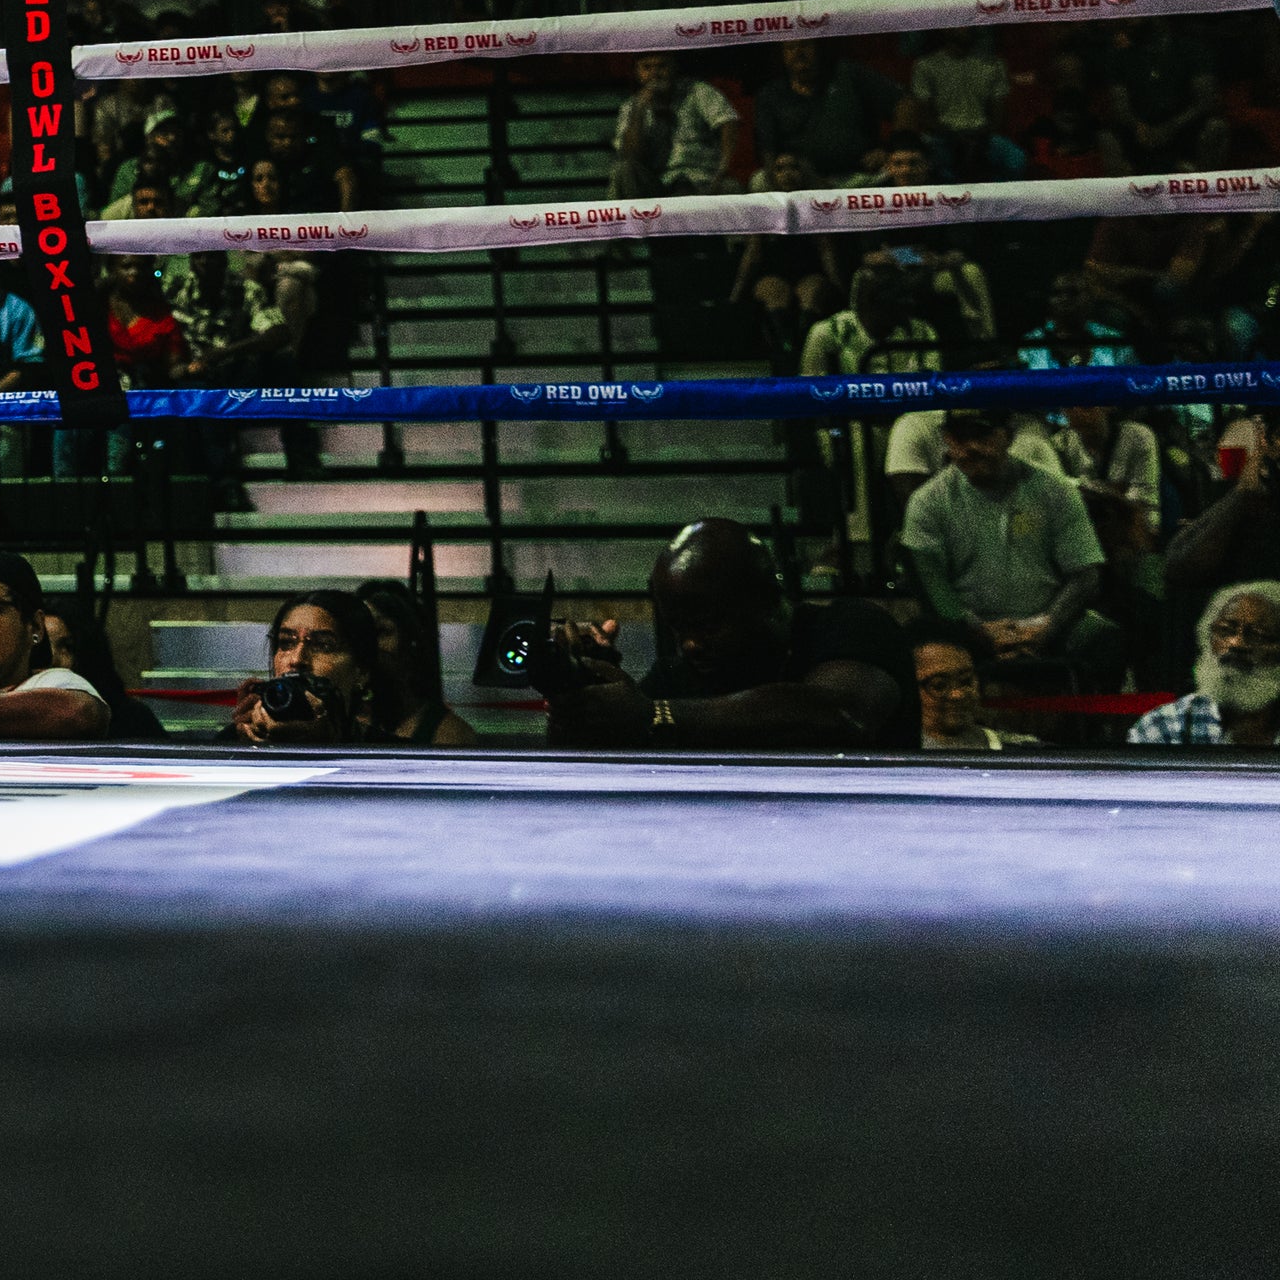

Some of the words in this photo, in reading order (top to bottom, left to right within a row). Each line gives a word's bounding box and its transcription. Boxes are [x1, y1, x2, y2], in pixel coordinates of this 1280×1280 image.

[710, 19, 748, 36] RED
[752, 15, 793, 33] OWL
[424, 35, 461, 51] RED
[464, 32, 503, 49] OWL
[147, 46, 182, 62] RED
[186, 44, 223, 61] OWL
[27, 61, 63, 174] OWL
[1168, 178, 1209, 195] RED
[1215, 176, 1261, 193] OWL
[846, 194, 884, 210] RED
[891, 192, 934, 208] OWL
[544, 211, 581, 227] RED
[587, 207, 627, 223] OWL
[257, 226, 292, 240] RED
[296, 225, 335, 240] OWL
[33, 192, 100, 391] BOXING
[847, 382, 885, 399] RED
[891, 381, 935, 397] OWL
[1167, 375, 1207, 391] RED
[1214, 371, 1258, 388] OWL
[546, 385, 582, 401] RED
[587, 384, 627, 400] OWL
